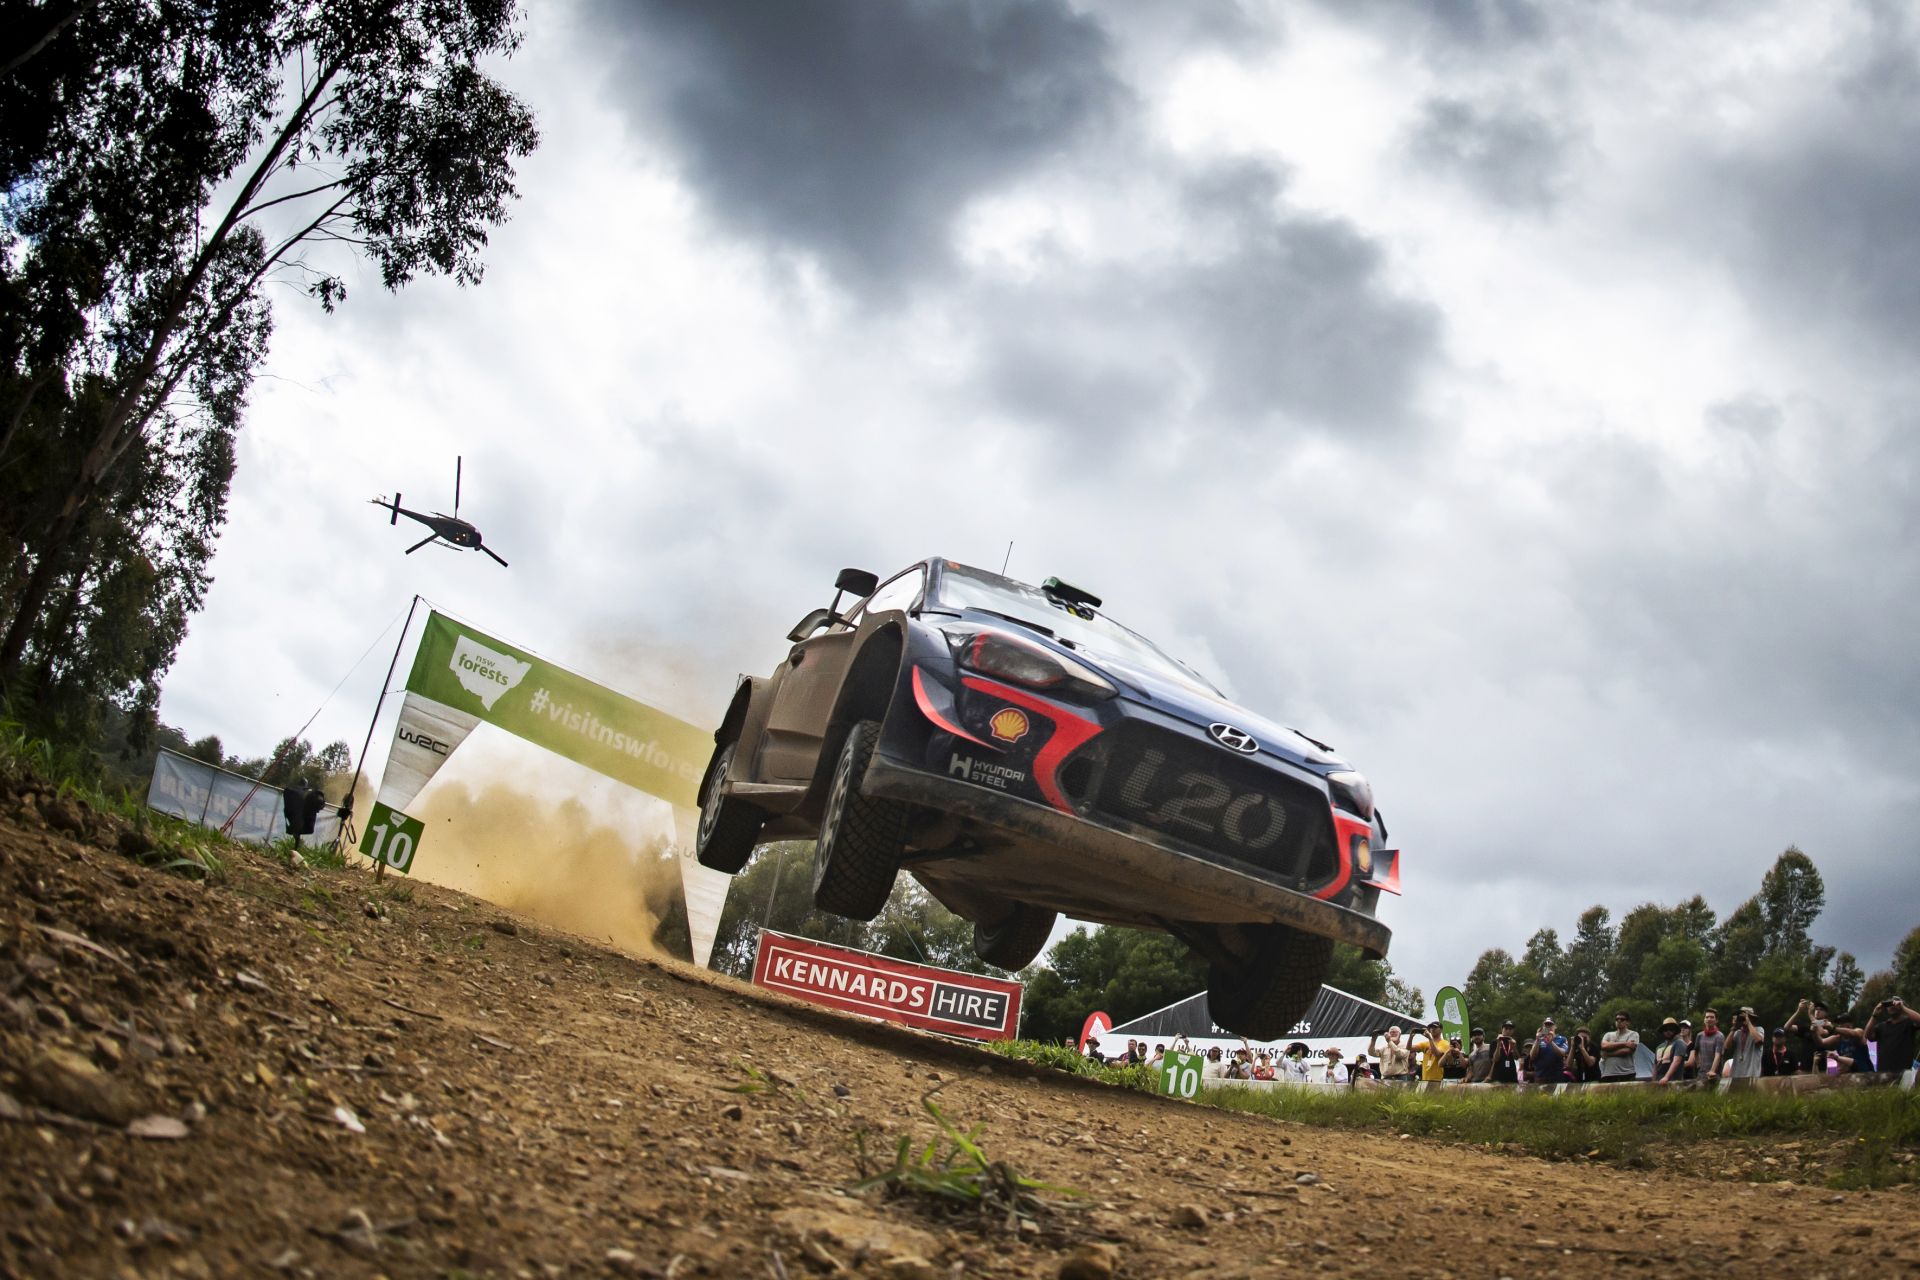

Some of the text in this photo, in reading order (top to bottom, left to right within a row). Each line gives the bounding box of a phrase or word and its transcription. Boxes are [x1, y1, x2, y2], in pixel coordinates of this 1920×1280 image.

[458, 653, 509, 686] forests
[475, 655, 496, 667] nsw
[399, 727, 449, 756] WRC
[530, 687, 705, 786] #visitnswfores
[971, 771, 1007, 788] STEEL
[973, 760, 1025, 782] HYUNDAI
[371, 823, 413, 869] 10
[774, 956, 999, 1021] KENNARDS HIRE
[1166, 1065, 1198, 1098] 10
